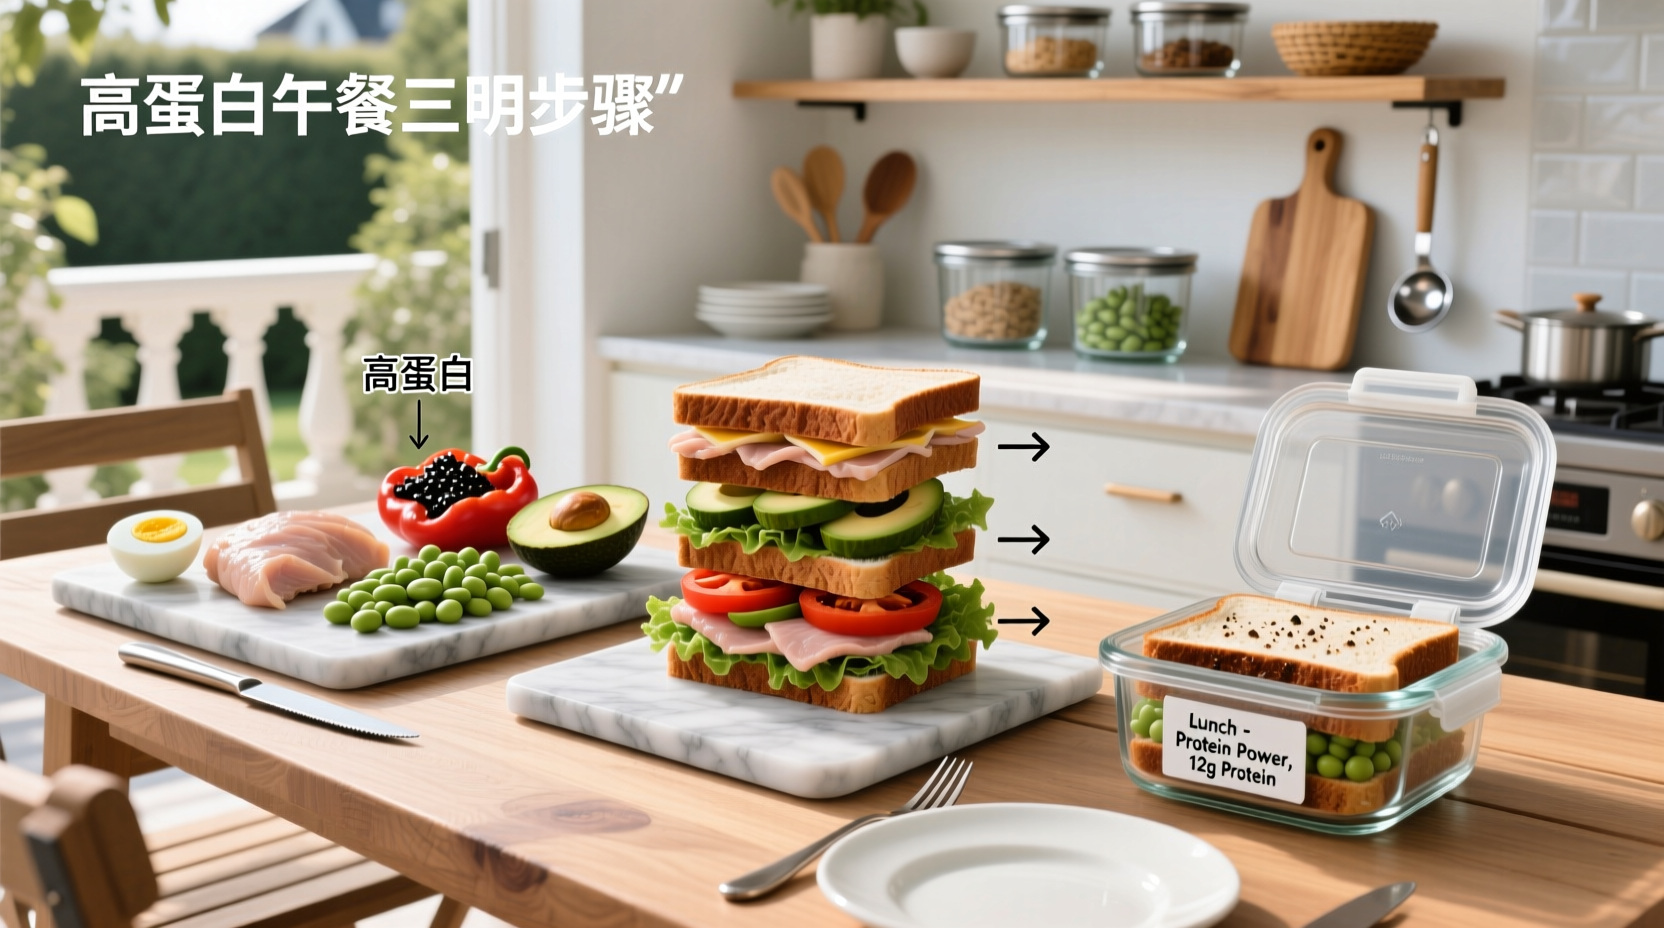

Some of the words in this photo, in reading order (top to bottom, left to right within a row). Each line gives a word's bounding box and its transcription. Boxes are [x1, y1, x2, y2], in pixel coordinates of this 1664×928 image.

[1189, 712, 1237, 736] Lunch
[1176, 730, 1231, 756] Protein
[1237, 742, 1293, 772] Power,
[1189, 755, 1217, 780] 12g
[1221, 760, 1276, 787] Protein
